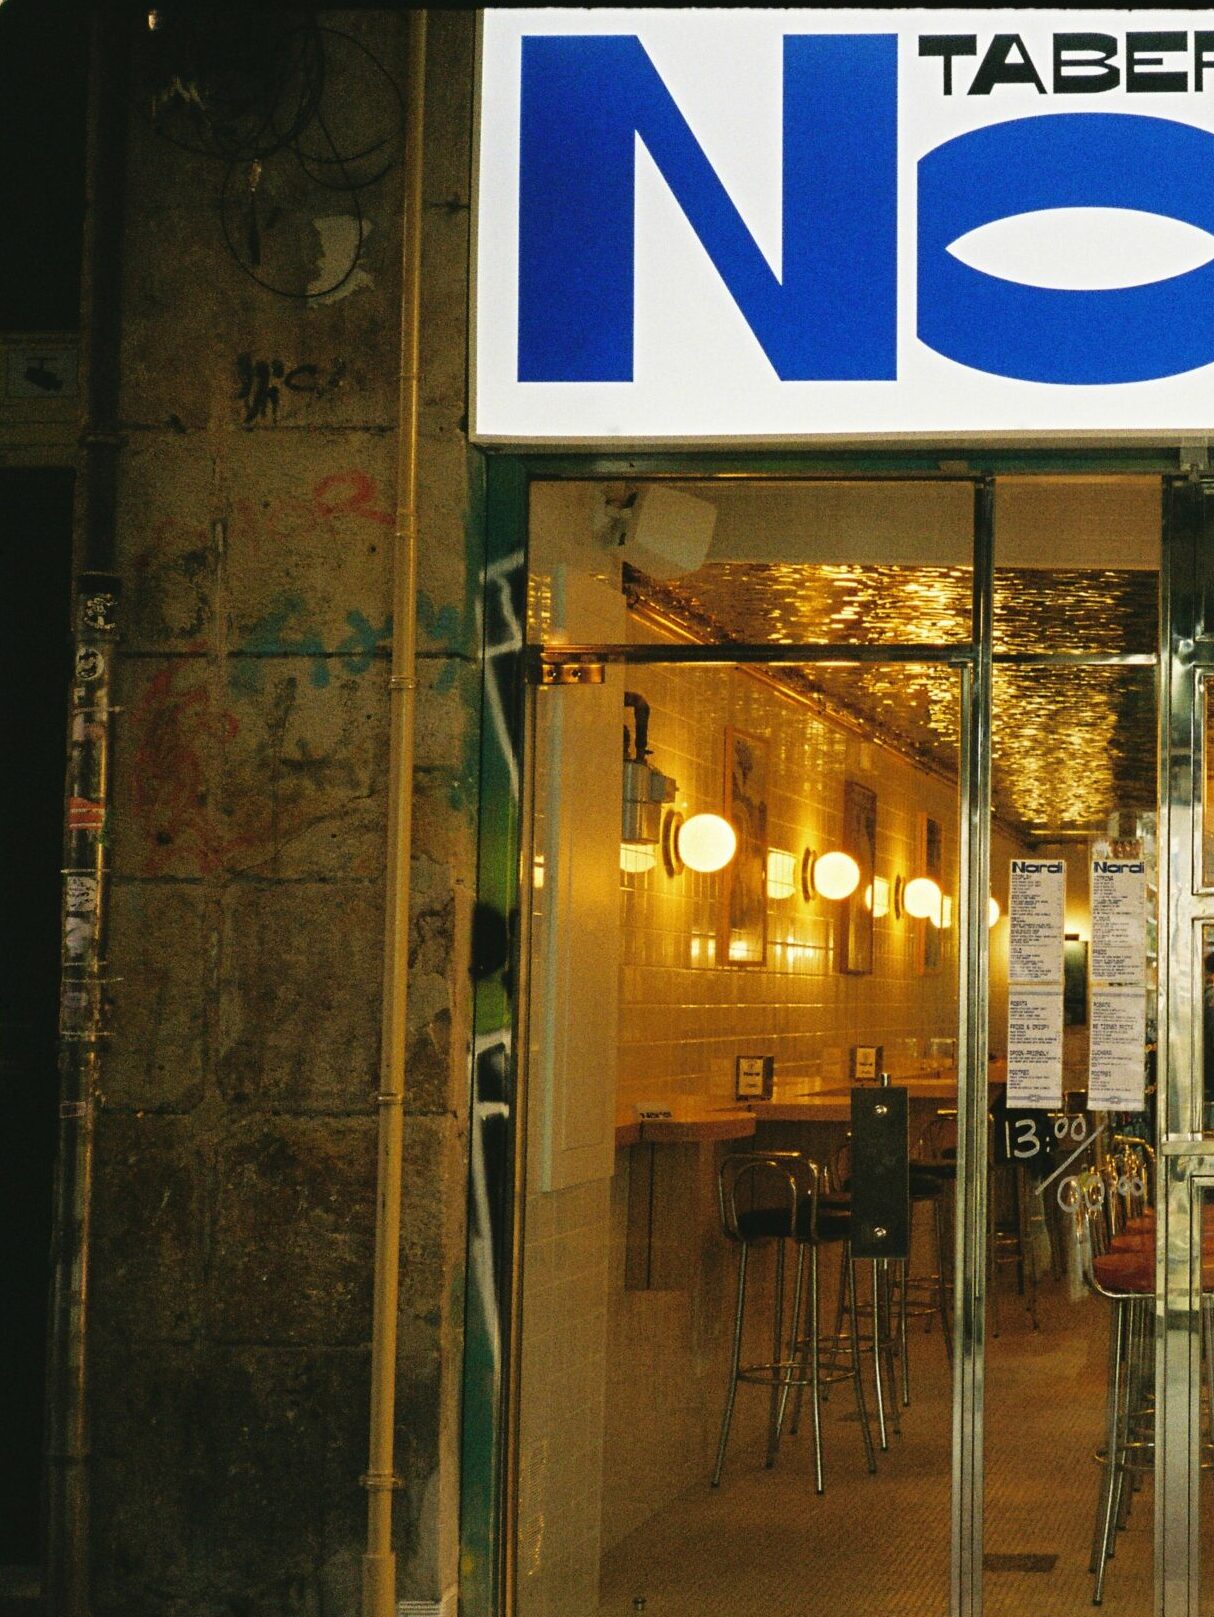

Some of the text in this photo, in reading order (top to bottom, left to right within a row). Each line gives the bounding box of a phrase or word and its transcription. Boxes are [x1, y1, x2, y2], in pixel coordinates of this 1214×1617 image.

[1012, 861, 1063, 874] Nardi
[1094, 861, 1145, 874] Nardi
[1005, 1117, 1087, 1159] 13:00
